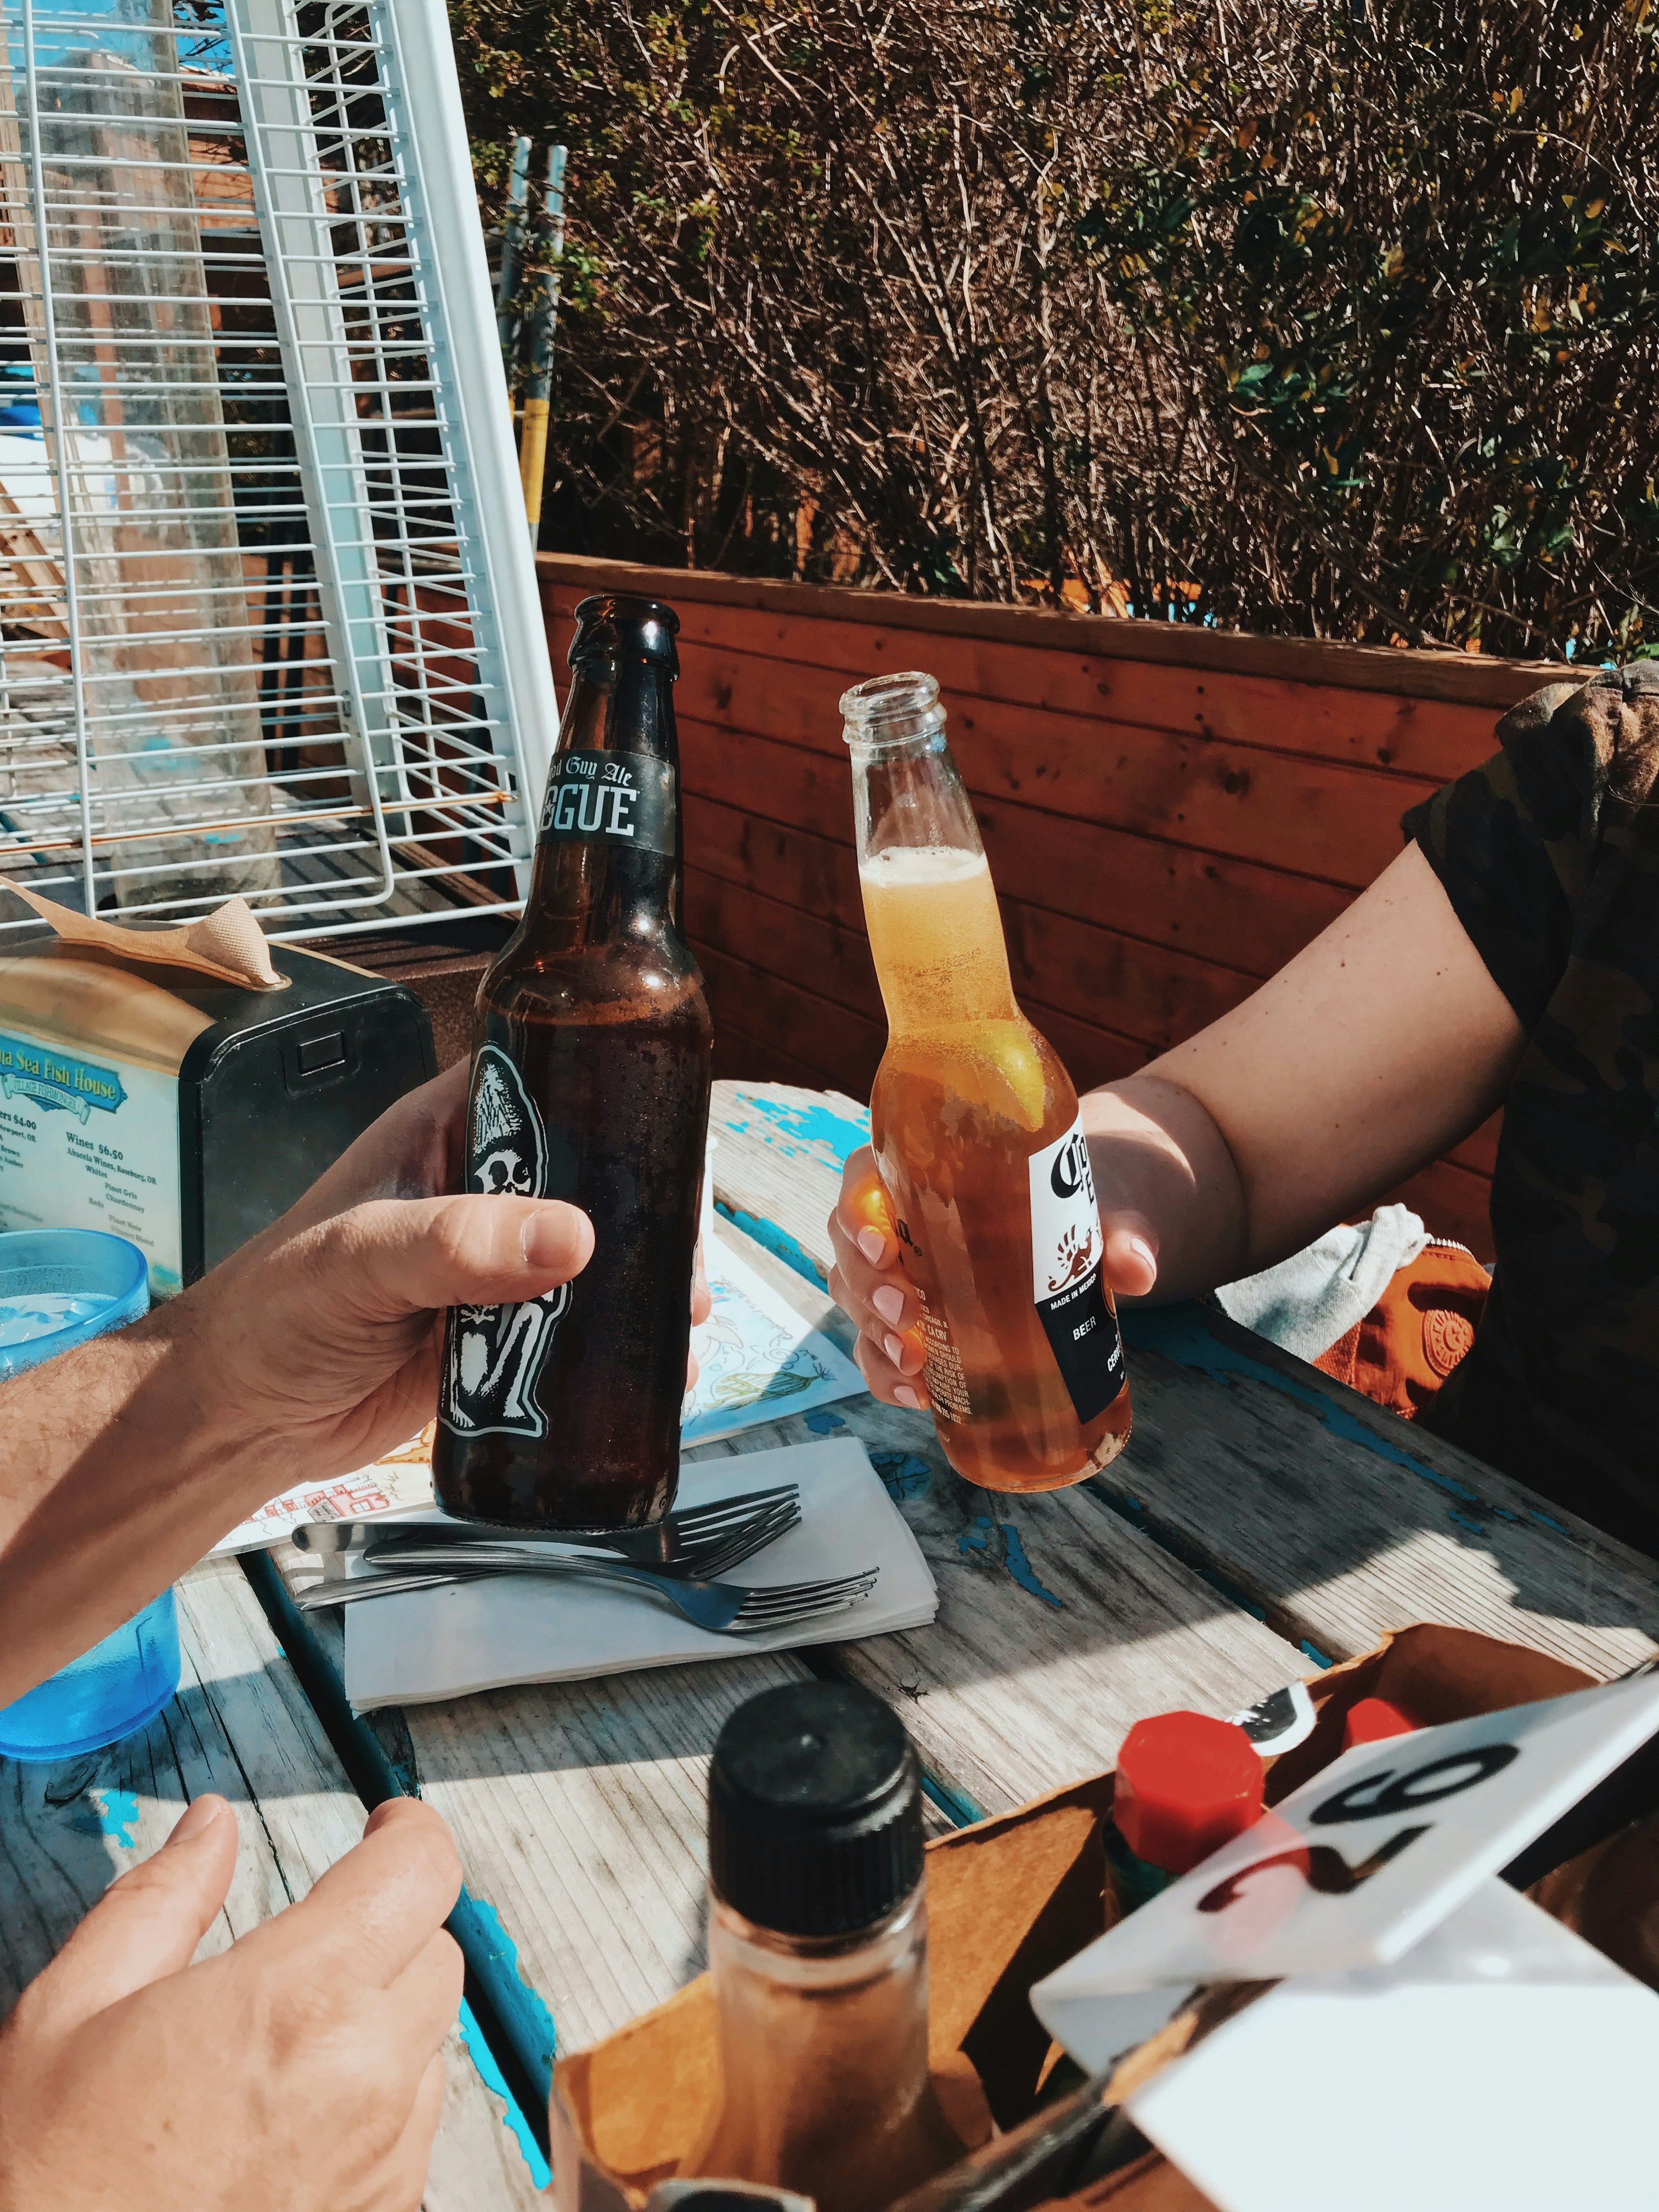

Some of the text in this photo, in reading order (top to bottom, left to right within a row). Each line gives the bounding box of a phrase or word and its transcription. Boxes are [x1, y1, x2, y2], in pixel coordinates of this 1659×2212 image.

[566, 756, 597, 780] Guy
[601, 763, 632, 786] Ale
[540, 784, 637, 837] OGUE
[0, 1049, 115, 1099] na Sea Fish House
[0, 1111, 36, 1130] ers $4.00
[0, 1125, 26, 1139] ewport,
[27, 1133, 36, 1143] OR
[66, 1132, 123, 1160] Wines $6.50
[86, 1164, 108, 1178] Whites
[93, 1155, 116, 1172] Wines,
[147, 1176, 157, 1185] OR
[105, 1182, 137, 1199] Pinot Gris
[106, 1193, 144, 1214] Chardonnay
[1051, 1273, 1096, 1310] MADE IN MEXICO
[927, 1324, 936, 1337] CA
[1073, 1316, 1096, 1340] BEER
[925, 1335, 960, 1355] ACCORDING TO
[939, 1350, 961, 1363] SHOULD
[1107, 1341, 1120, 1372] CERV
[934, 1362, 944, 1374] THE
[944, 1368, 957, 1379] RISK
[957, 1373, 965, 1381] OF
[952, 1386, 969, 1398] YOUR
[952, 1395, 971, 1406] MACH-
[944, 1398, 973, 1415] PROBLEMS.
